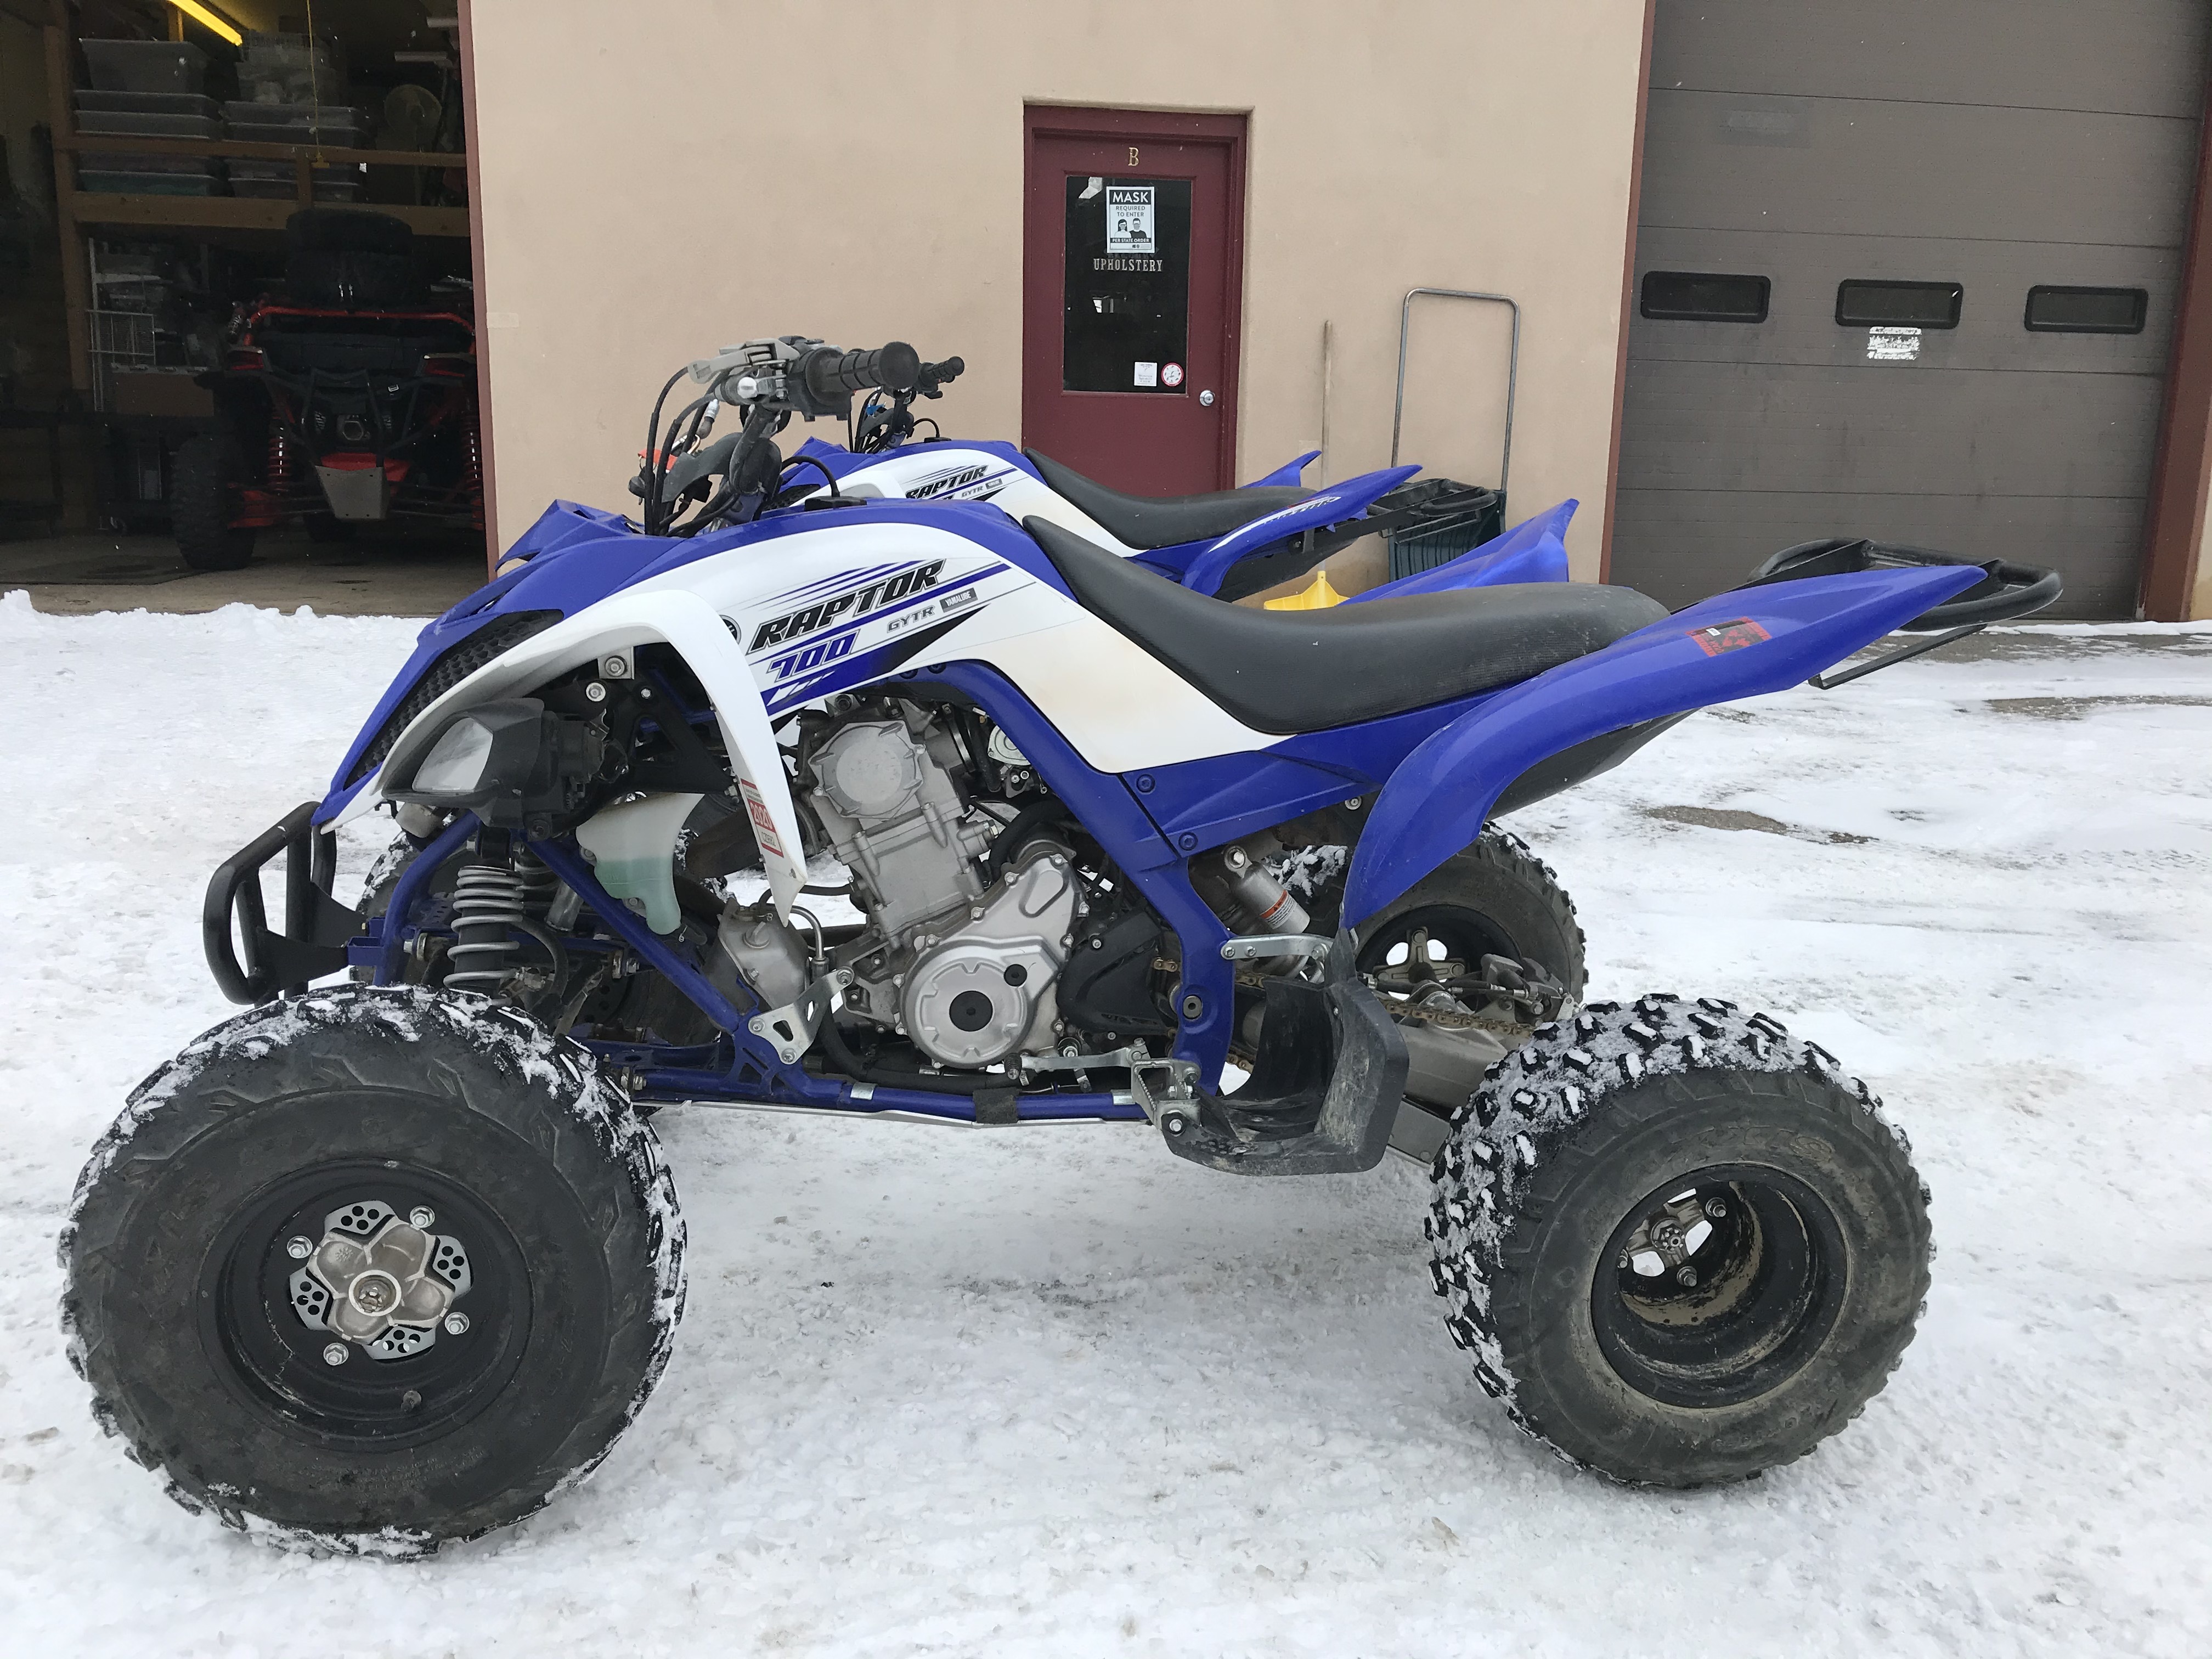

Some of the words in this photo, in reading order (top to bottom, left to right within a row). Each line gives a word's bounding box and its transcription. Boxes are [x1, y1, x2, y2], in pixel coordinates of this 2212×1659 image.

[1128, 147, 1139, 166] B
[1113, 191, 1148, 203] MASK
[1093, 258, 1163, 272] UPHOLSTERY
[905, 465, 988, 499] RAPTOR
[961, 486, 984, 498] GYTR
[745, 558, 946, 655] RAPTOR
[945, 591, 972, 607] YAMALUBE
[887, 605, 935, 633] GYTR
[766, 629, 861, 682] 700
[749, 802, 773, 830] 2020
